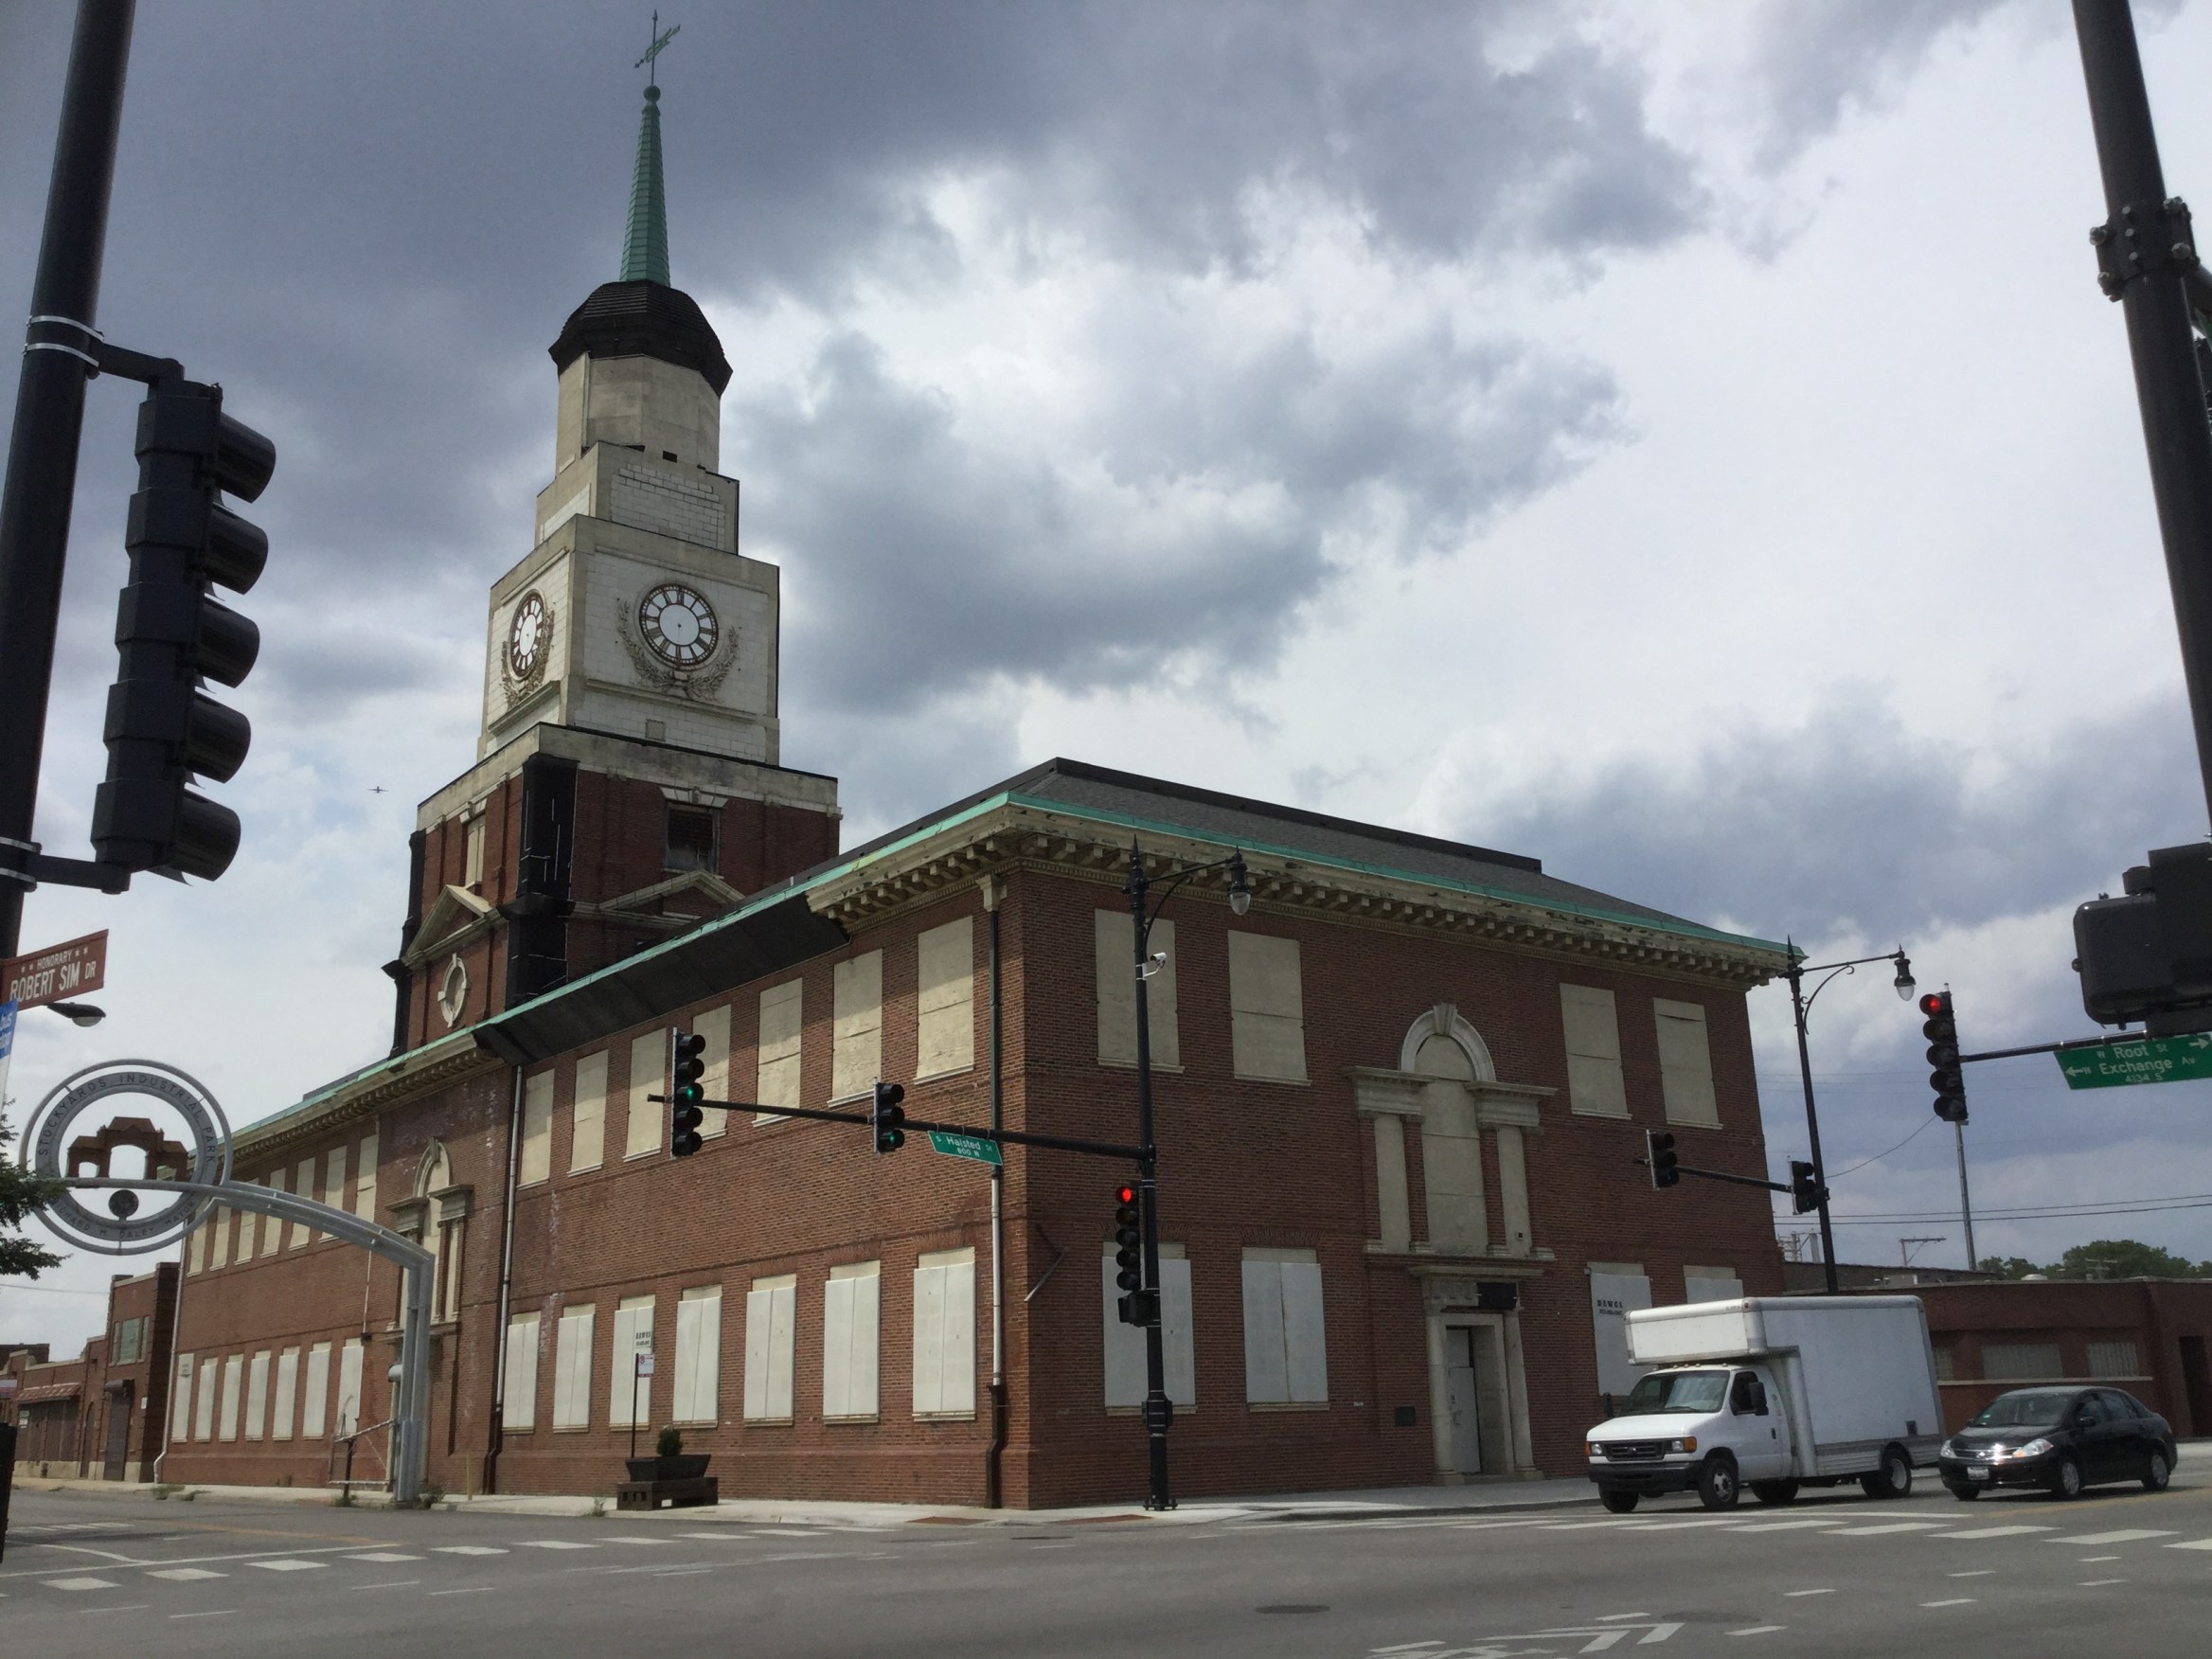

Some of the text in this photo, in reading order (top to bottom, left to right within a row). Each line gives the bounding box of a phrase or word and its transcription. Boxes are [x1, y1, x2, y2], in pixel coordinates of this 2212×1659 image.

[37, 950, 73, 971] HONORARY
[10, 960, 97, 1002] ROBERT SIM DR
[2096, 1044, 2168, 1059] W Root St
[2082, 1056, 2196, 1075] W Exchange Av
[2125, 1072, 2164, 1082] 4134 S
[38, 1073, 217, 1163] STOCKYARDS INDUSTRIAL PARK
[946, 1135, 981, 1151] Halsted
[119, 1227, 153, 1239] DALEY
[164, 1202, 194, 1227] MAYOR
